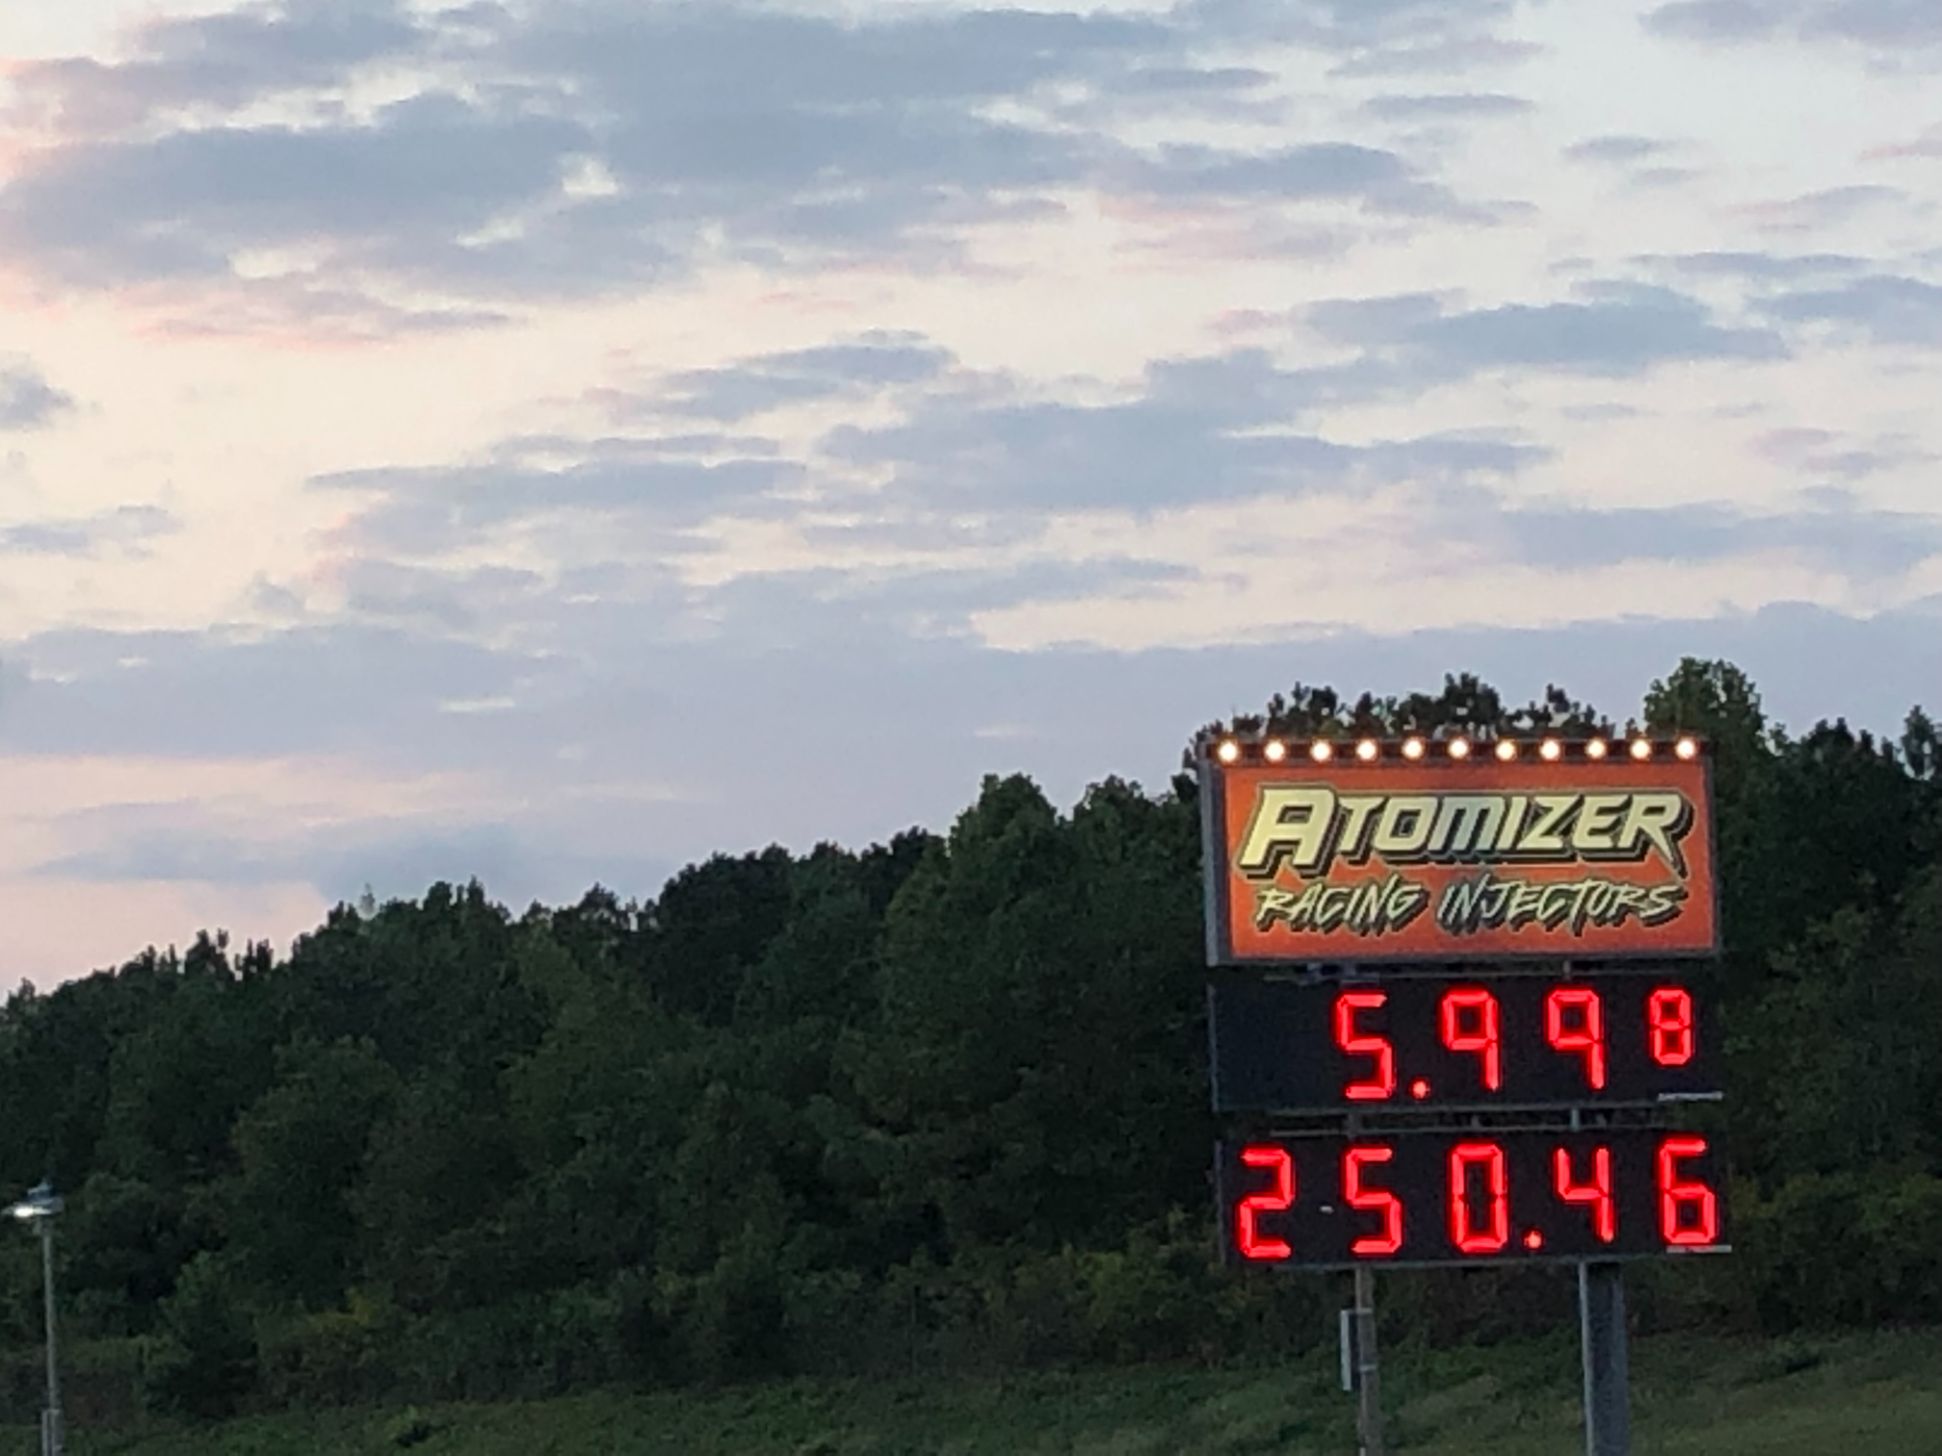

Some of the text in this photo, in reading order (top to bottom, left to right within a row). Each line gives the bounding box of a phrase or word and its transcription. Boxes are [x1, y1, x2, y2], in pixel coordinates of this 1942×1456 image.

[1238, 786, 1691, 874] ATOMIZER
[1257, 874, 1687, 936] RACING INJECTORS
[1335, 988, 1692, 1099] 5.998
[1238, 1138, 1716, 1257] 250.46
